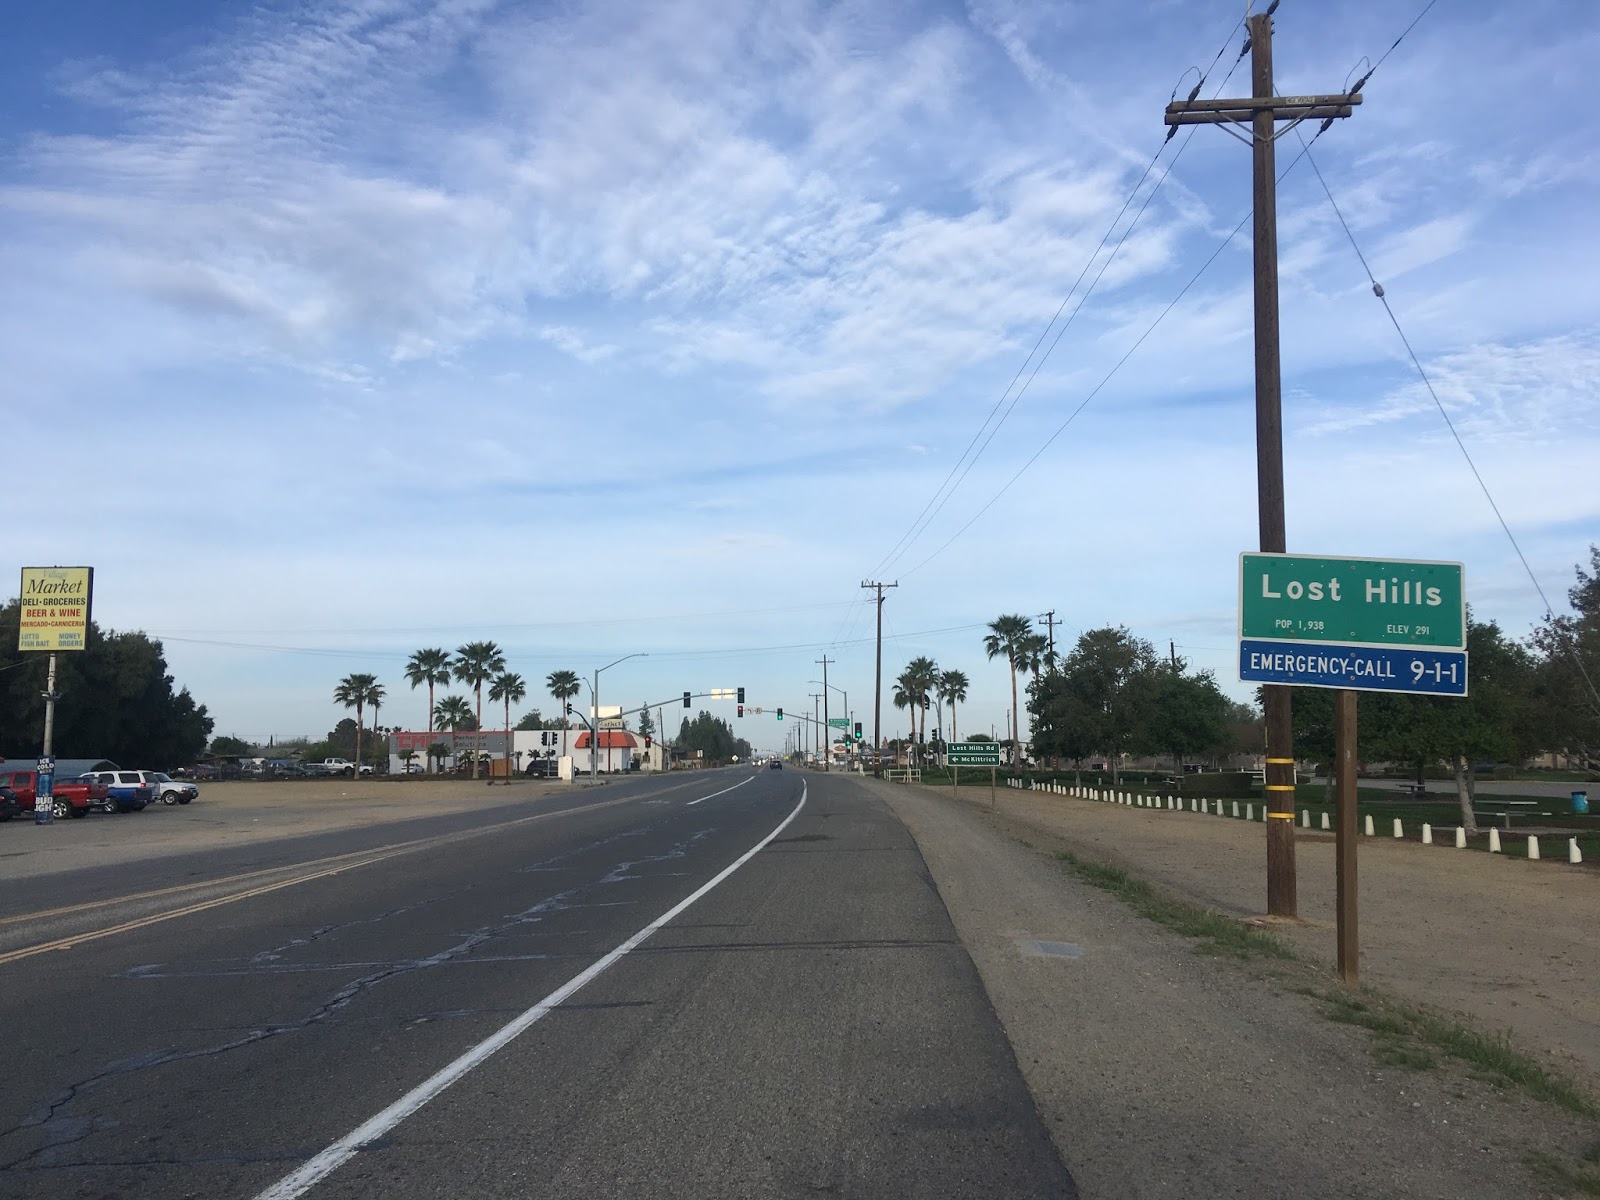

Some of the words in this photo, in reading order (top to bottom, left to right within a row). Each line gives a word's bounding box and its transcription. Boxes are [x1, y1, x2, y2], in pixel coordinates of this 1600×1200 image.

[26, 579, 83, 594] Market
[1261, 573, 1342, 602] Lost
[1365, 577, 1443, 607] Hills
[26, 608, 47, 617] BEER
[49, 608, 56, 617] &
[59, 608, 81, 617] WINE
[1275, 619, 1293, 629] POP
[1298, 620, 1325, 631] 1,938
[1387, 624, 1409, 634] ELEV
[1415, 625, 1430, 635] 291
[1410, 660, 1457, 684] 9-1-1
[35, 796, 53, 805] BUD
